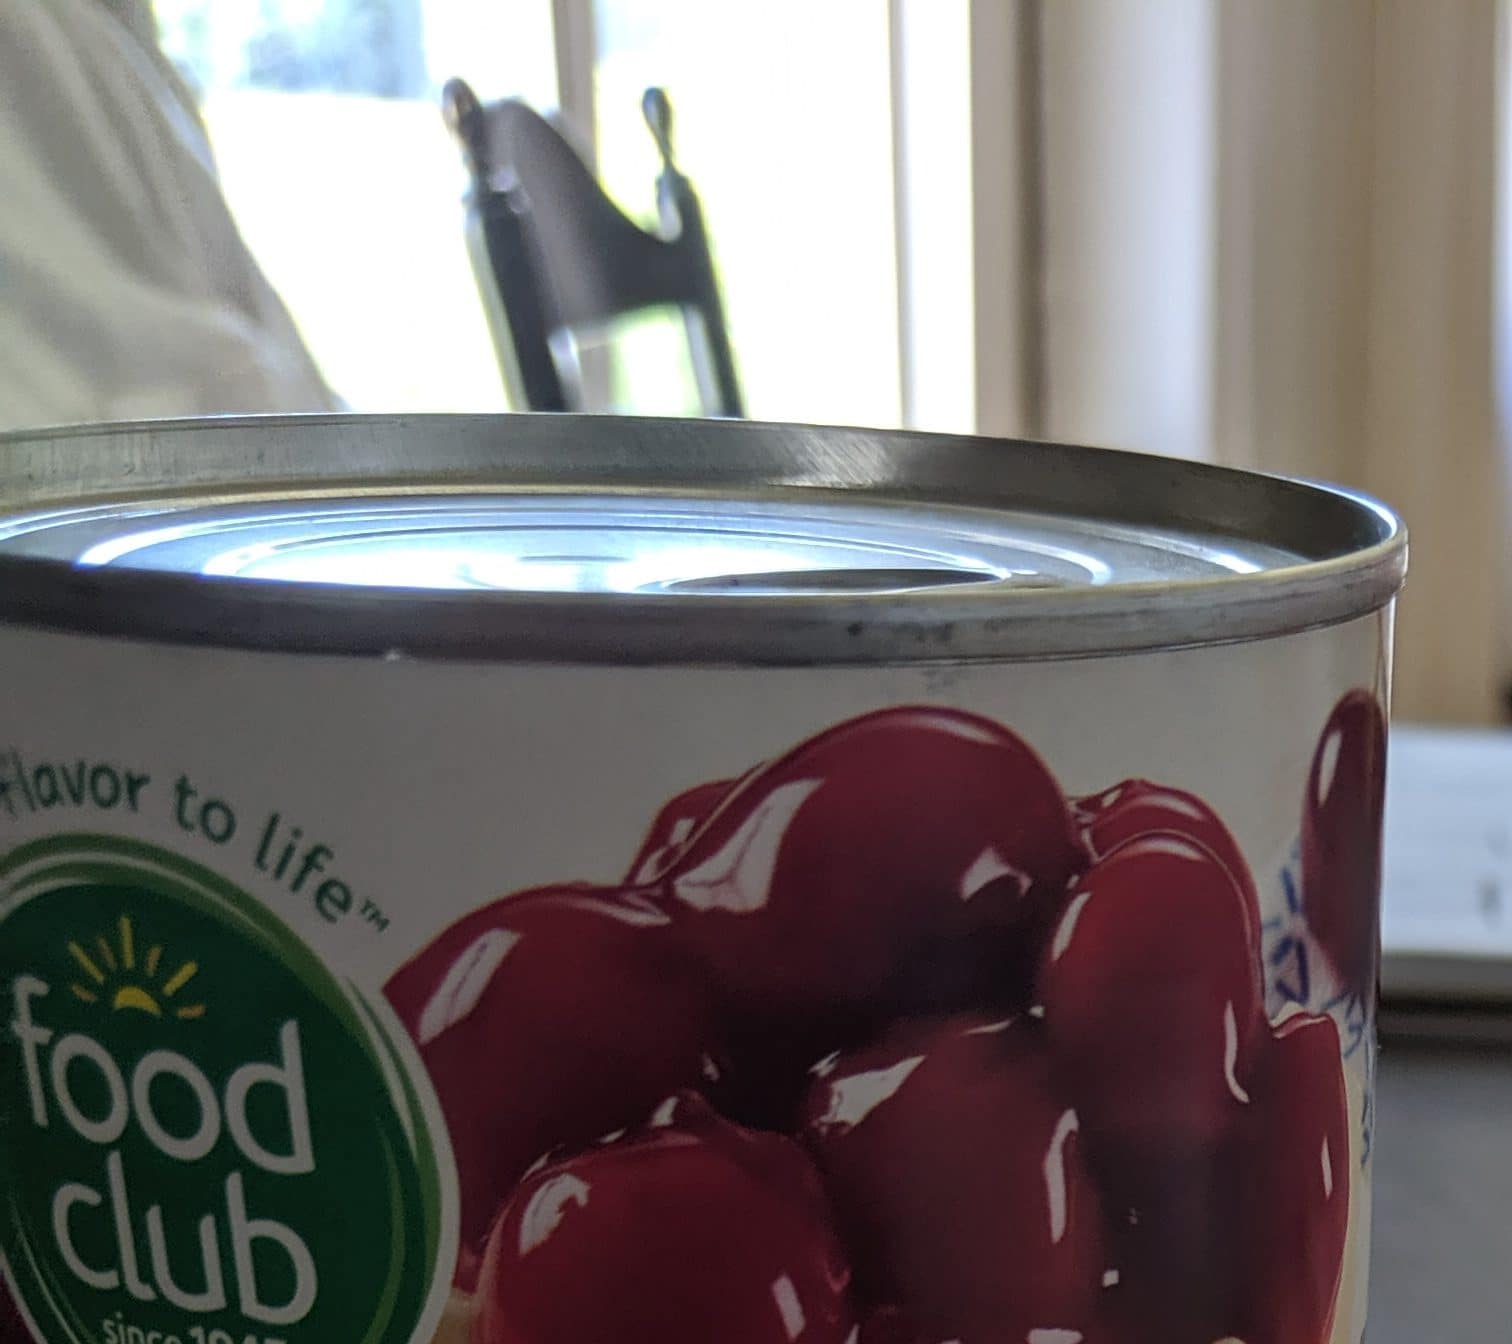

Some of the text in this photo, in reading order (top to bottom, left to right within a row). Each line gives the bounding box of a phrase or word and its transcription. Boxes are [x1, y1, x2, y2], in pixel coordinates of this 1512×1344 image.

[173, 774, 237, 844] to
[11, 974, 316, 1174] food
[52, 1149, 318, 1326] club
